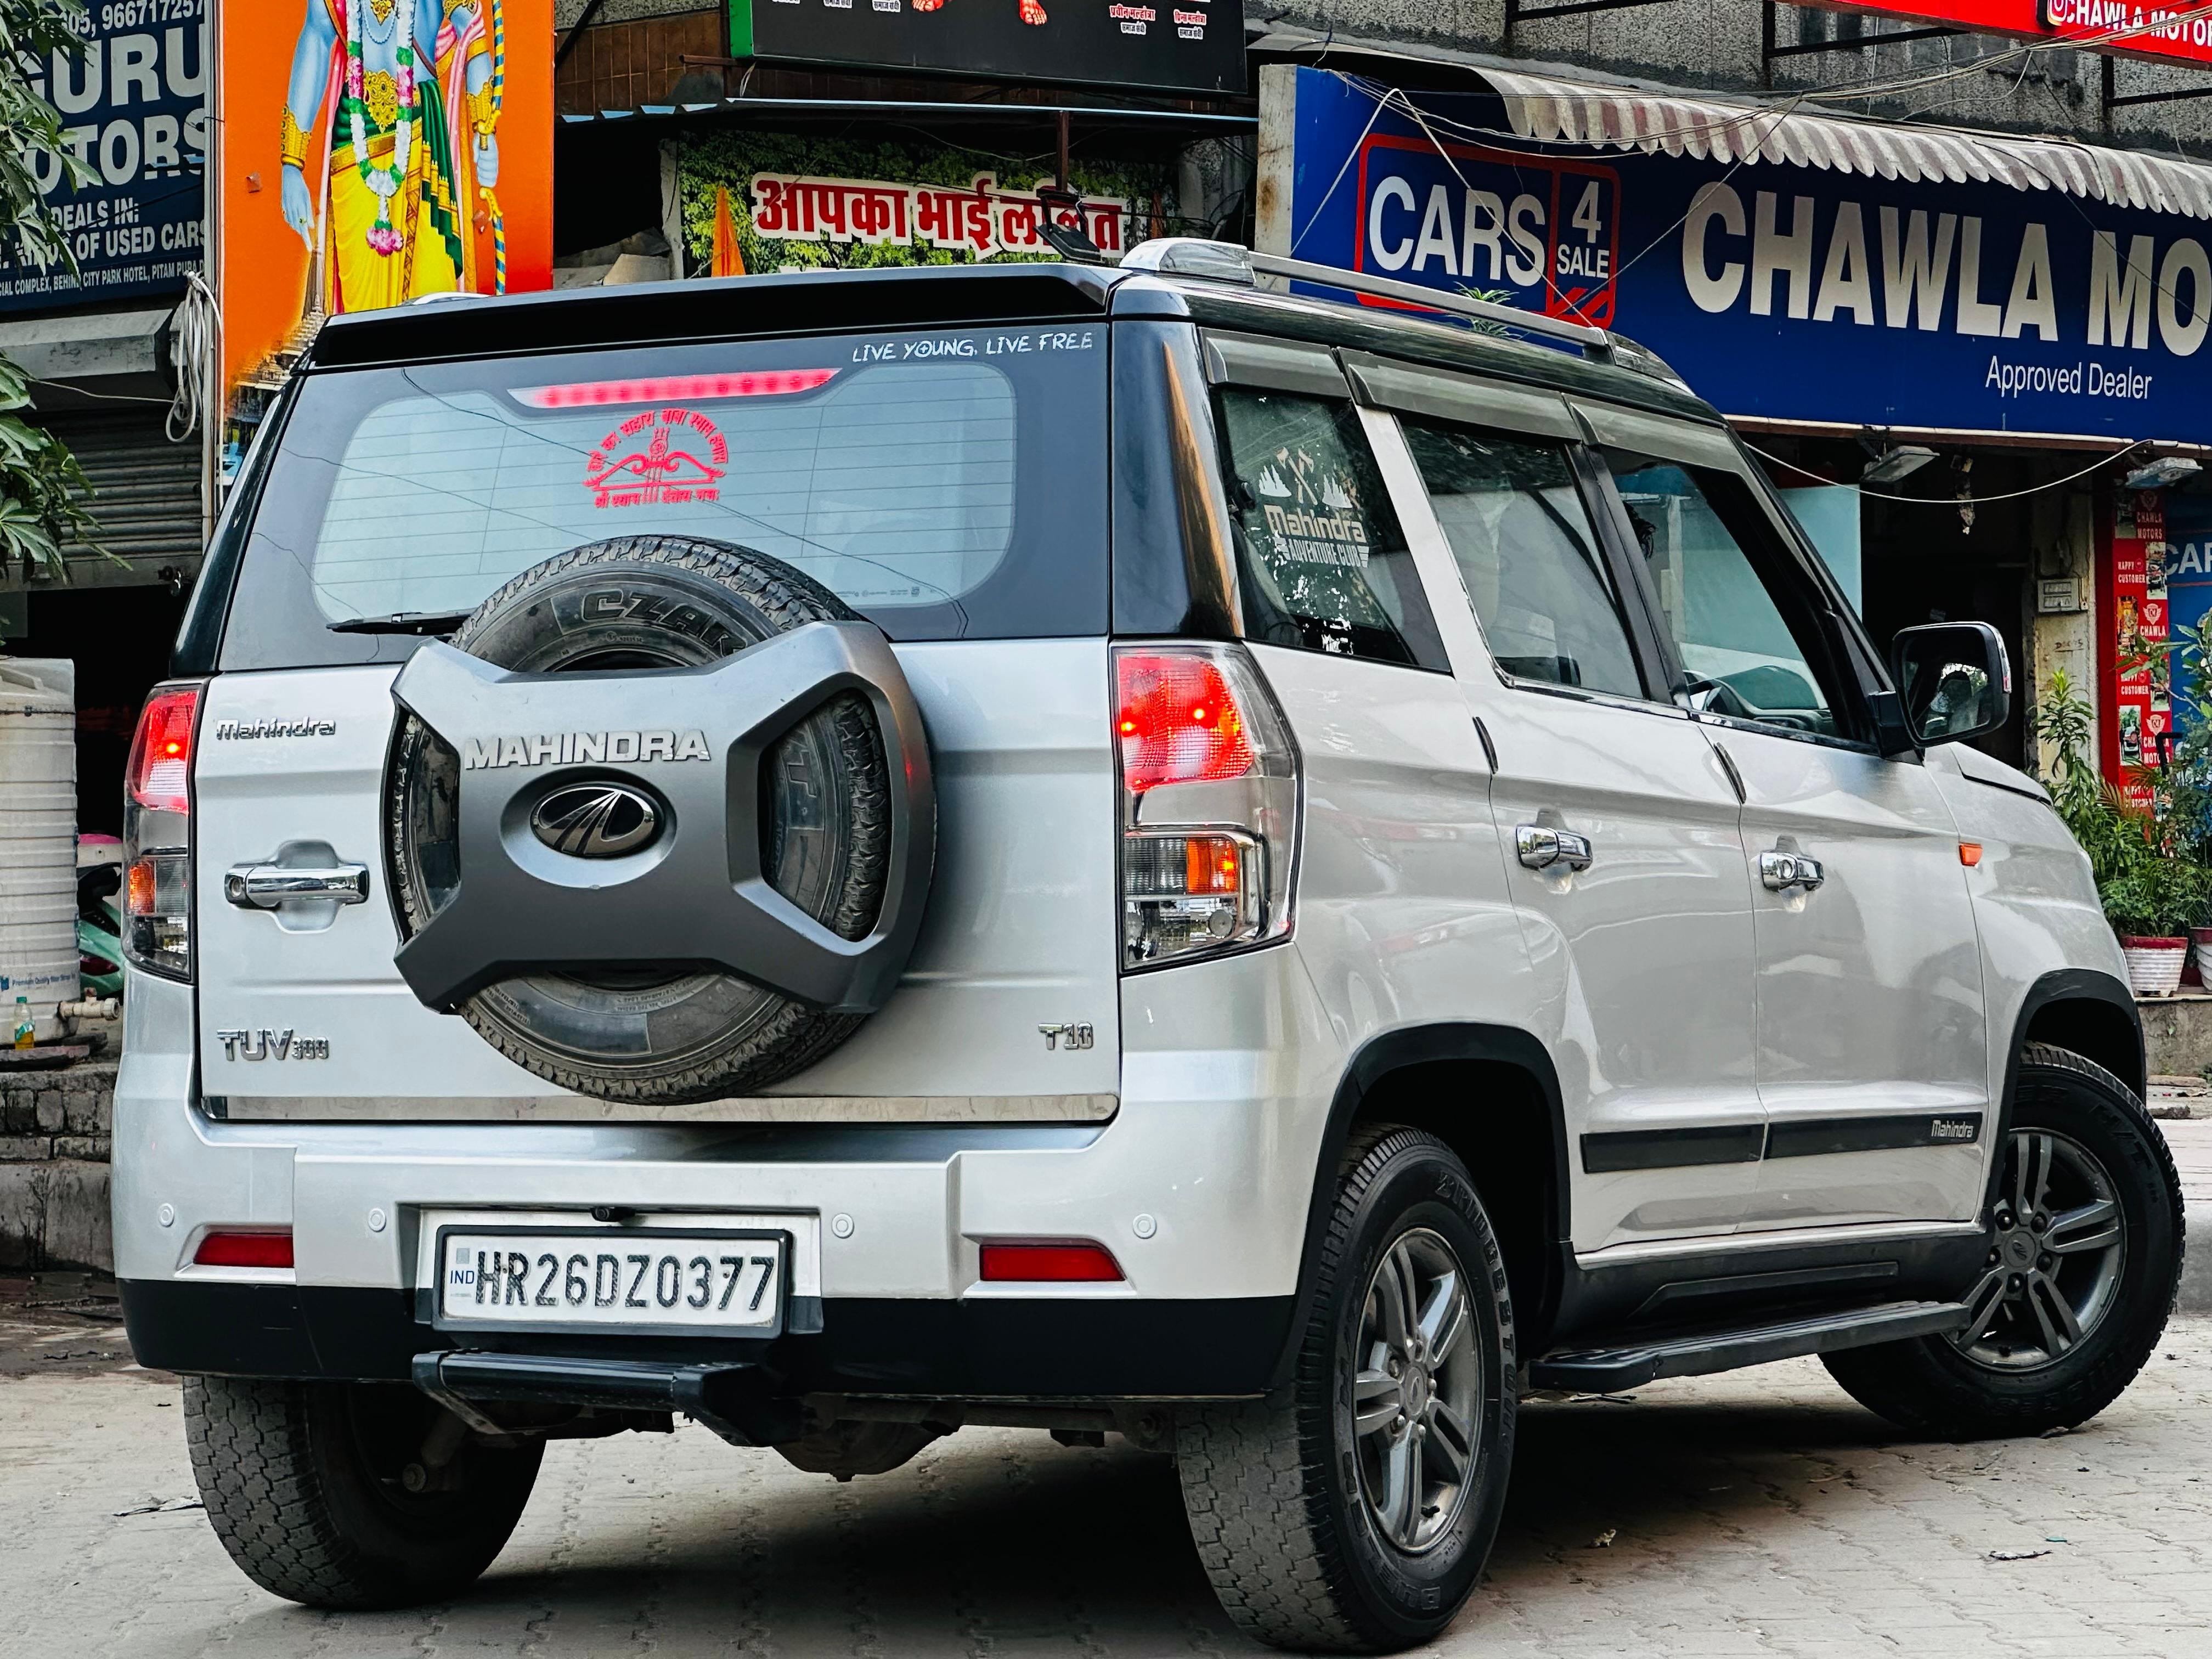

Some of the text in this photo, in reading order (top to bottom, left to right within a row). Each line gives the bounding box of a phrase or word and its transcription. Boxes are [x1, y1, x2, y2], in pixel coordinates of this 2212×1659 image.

[2067, 0, 2144, 33] CHAWLA
[24, 108, 205, 195] OTORS
[51, 197, 139, 232] DEALS IN:
[757, 180, 909, 238] आपका
[917, 179, 992, 250] भाई
[1572, 181, 1601, 243] 4
[76, 232, 100, 261] OF
[106, 225, 155, 257] USED
[1369, 176, 1545, 287] CARS
[15, 275, 52, 294] COMPLEX,
[53, 274, 80, 291] BEHIN
[83, 270, 100, 287] CITY
[102, 268, 122, 285] PARK
[123, 265, 150, 284] HOTEL,
[152, 262, 175, 279] PITAM
[1556, 244, 1610, 280] SALE
[1683, 182, 2212, 357] CHAWLA MO
[852, 332, 1093, 363] LIVE YOUNG, LIVE FREE
[1985, 355, 2152, 399] Approved Dealer
[1263, 504, 1368, 543] Mahindra
[2137, 511, 2163, 523] CHAWLA
[2137, 528, 2163, 540] MOTORS
[1287, 538, 1362, 567] ADVENTURE CLUB
[2118, 561, 2135, 571] HAPPY
[2118, 573, 2146, 584] CUSTOMER
[2140, 625, 2166, 637] CHAWLA
[2121, 685, 2149, 695] CUSTOMER
[217, 715, 336, 740] Mahindra
[2143, 736, 2170, 747] CHAA
[464, 729, 712, 770] MAHINDRA
[2143, 752, 2170, 764] MOTS
[1037, 1020, 1094, 1051] T10
[1931, 1120, 1974, 1138] Mahindra
[450, 1250, 775, 1311] IND HR26DZ0377
